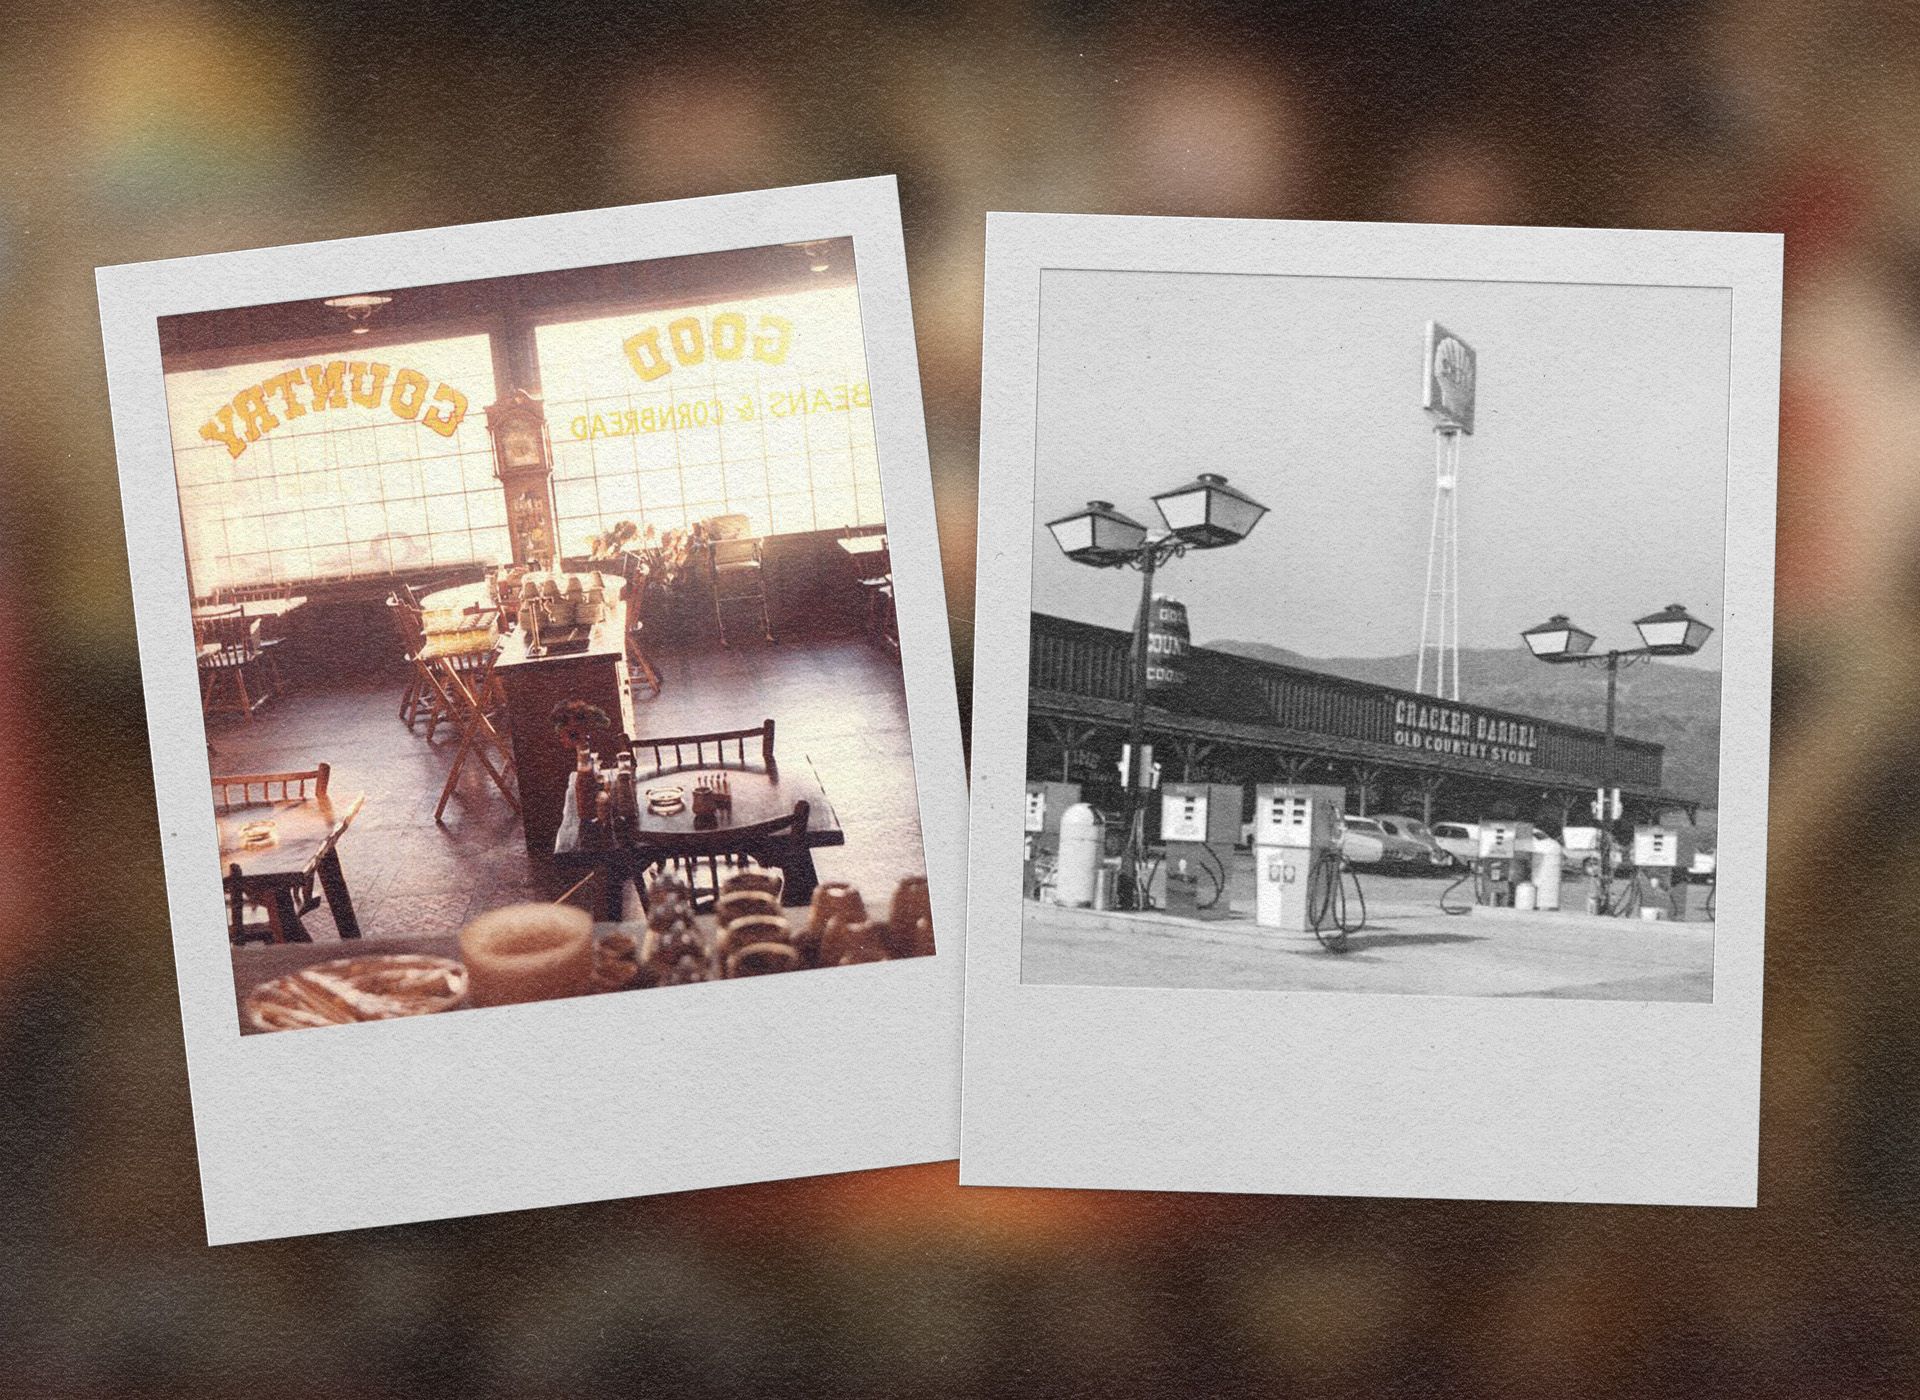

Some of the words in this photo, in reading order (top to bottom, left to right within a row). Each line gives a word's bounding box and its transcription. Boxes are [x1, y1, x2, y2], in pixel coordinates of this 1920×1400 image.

[1395, 700, 1470, 736] CRACKER
[1477, 716, 1537, 748] BARREL
[1394, 730, 1422, 748] OLD
[1425, 735, 1487, 759] COUNTRY
[1490, 746, 1532, 766] STORE
